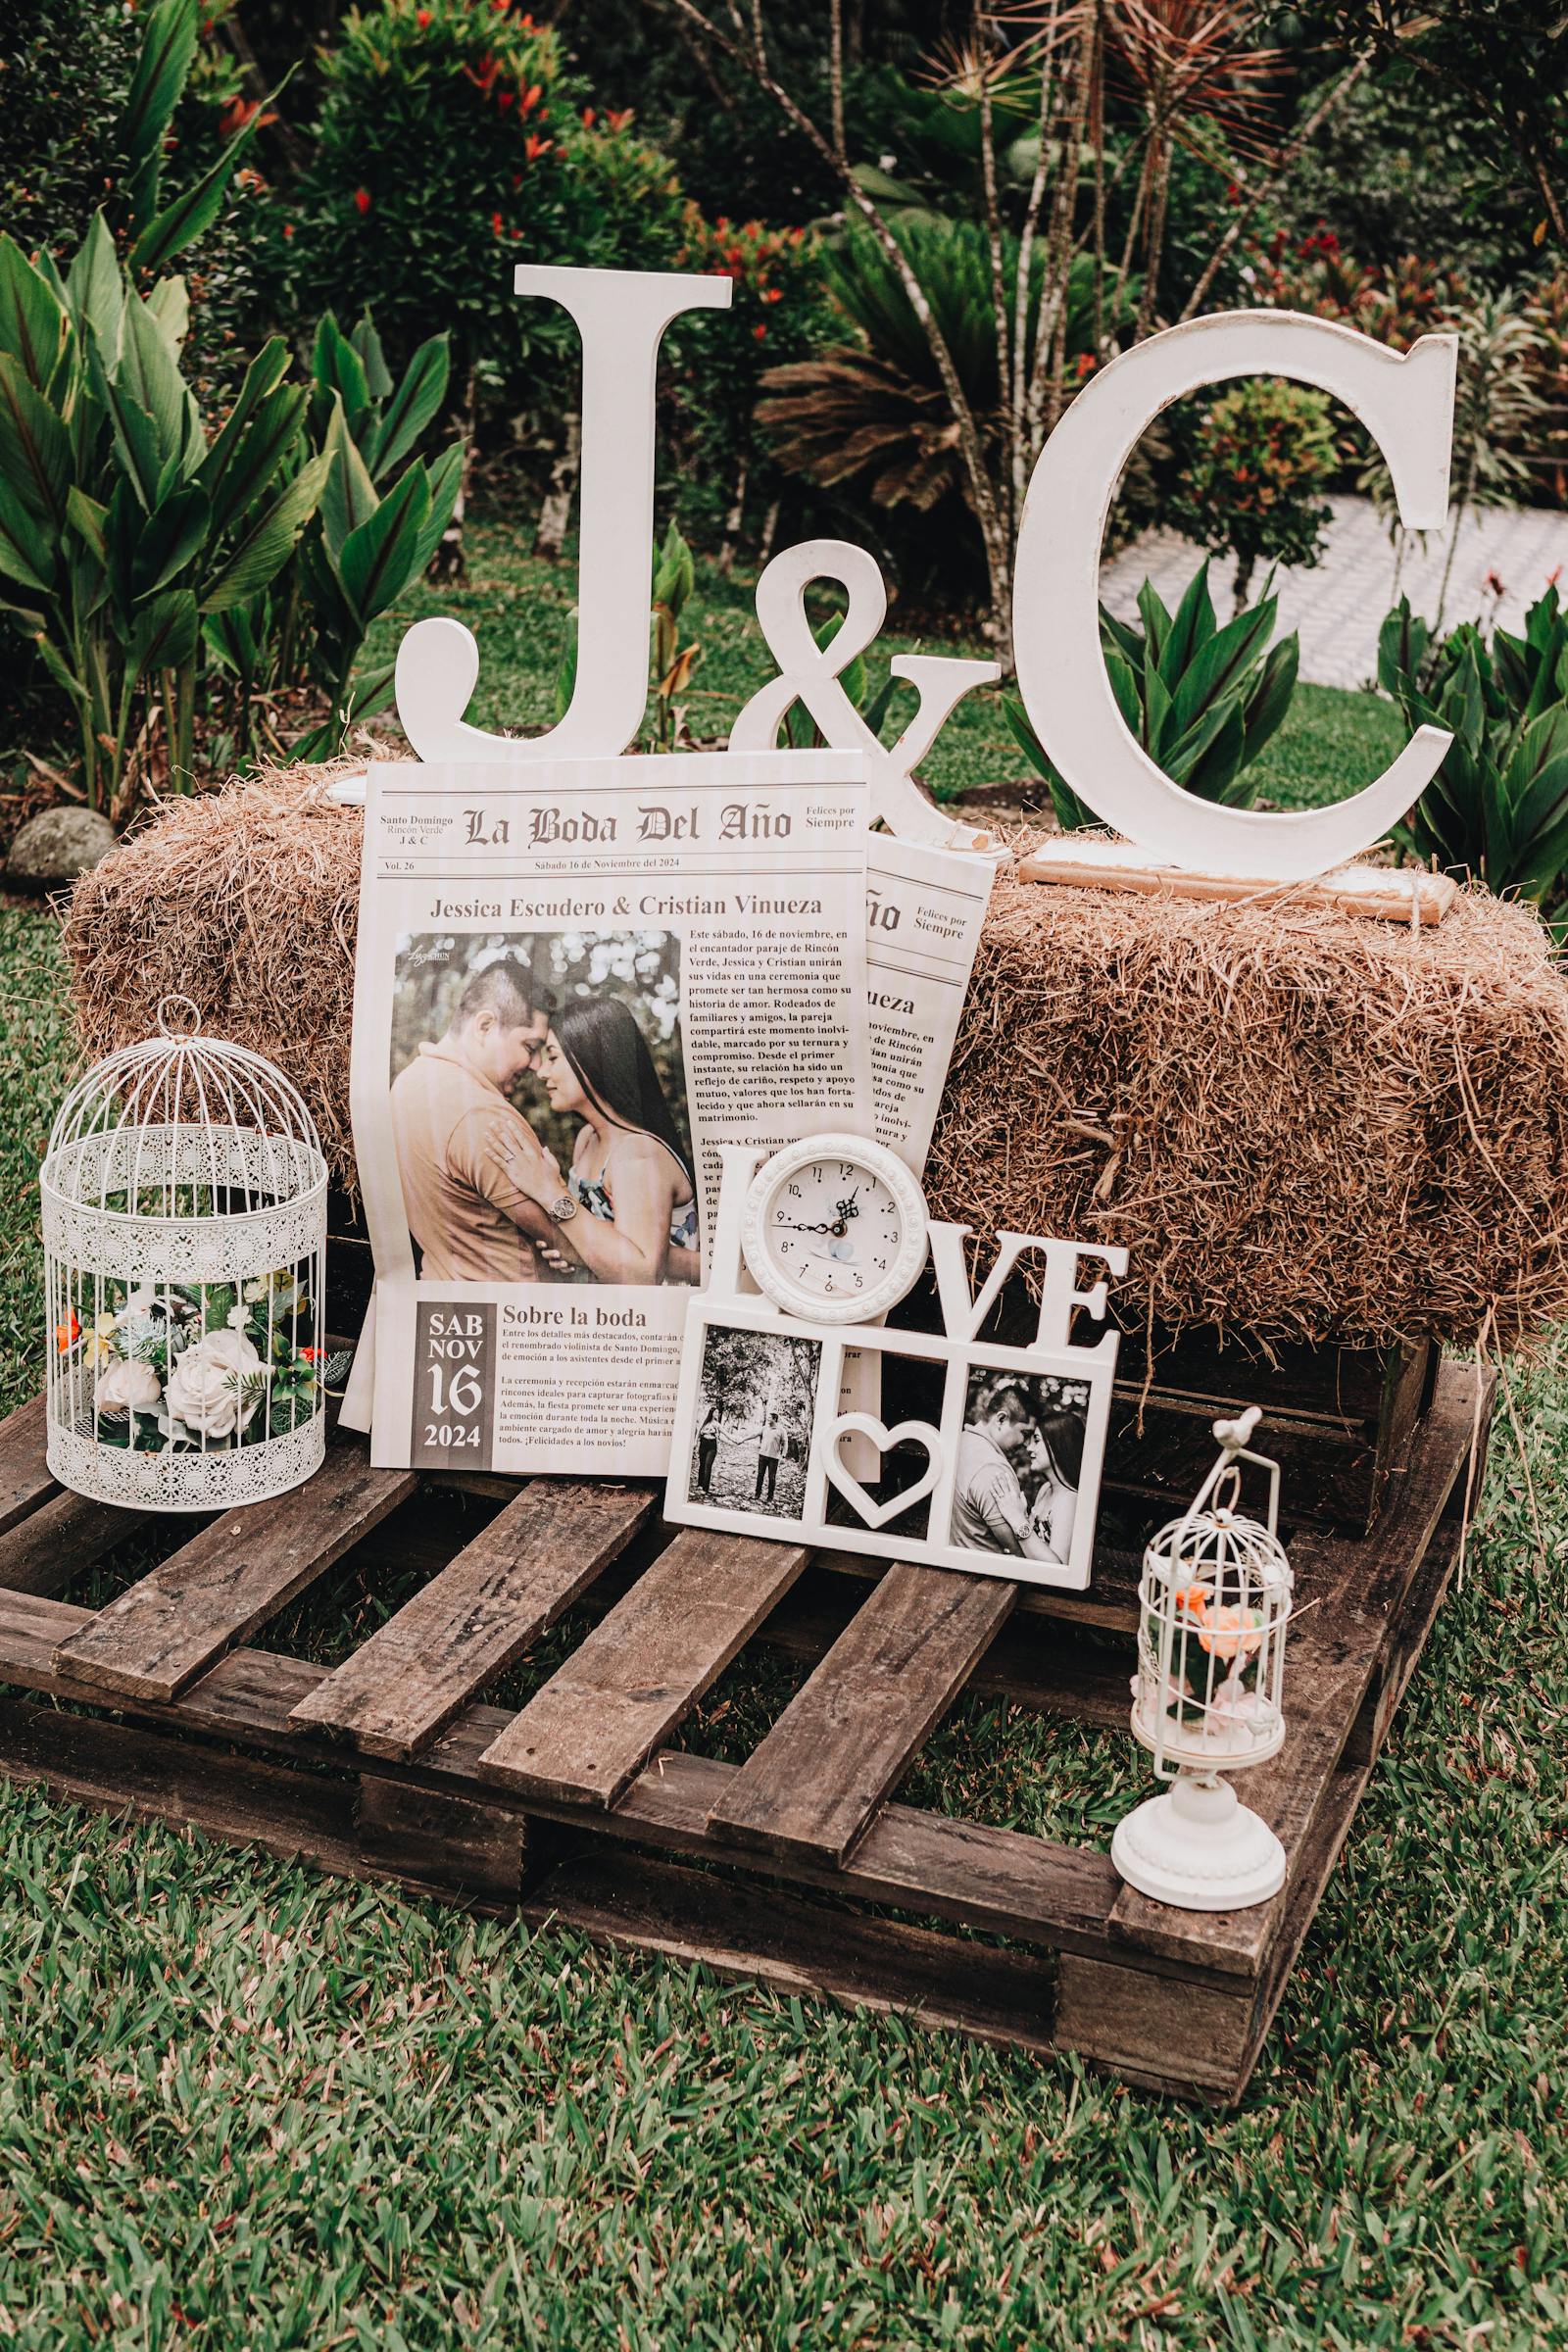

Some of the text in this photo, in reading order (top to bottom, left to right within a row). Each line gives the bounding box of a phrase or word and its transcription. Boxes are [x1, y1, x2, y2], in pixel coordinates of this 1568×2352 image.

[396, 264, 732, 760] J
[1013, 309, 1457, 880] C
[807, 807, 856, 817] Felices por
[381, 815, 453, 826] Santo Domingo
[806, 817, 855, 828] Siempre
[387, 825, 443, 834] Rincón Verde
[463, 803, 792, 850] La Boda Del Año
[400, 836, 406, 845] J
[420, 836, 427, 845] C
[594, 858, 640, 868] Noviembre
[431, 896, 822, 918] Jessica Escudero & Cristian Vinueza
[917, 906, 966, 926] Felices por
[914, 917, 963, 939] Siempre
[701, 944, 753, 953] encantador
[757, 944, 787, 955] paraje
[791, 944, 801, 953] de
[805, 944, 839, 953] Rincón
[690, 958, 719, 967] Verde,
[689, 987, 728, 996] promete
[690, 1000, 725, 1008] historia
[802, 1013, 832, 1023] pareja
[691, 1027, 745, 1037] compartirá
[888, 1039, 923, 1054] Rincón
[693, 1053, 755, 1062] compromiso.
[890, 1054, 922, 1066] unirán
[752, 1063, 790, 1072] relación
[900, 1068, 917, 1079] que
[695, 1078, 725, 1087] reflejo
[743, 1076, 776, 1085] cariño,
[780, 1076, 814, 1085] respeto
[886, 1079, 910, 1090] como
[812, 1166, 821, 1178] 11
[839, 1163, 854, 1176] 12
[871, 1177, 877, 1188] 1
[788, 1184, 800, 1196] 10
[887, 1202, 896, 1213] 2
[777, 1211, 785, 1222] 9
[890, 1232, 898, 1243] 3
[781, 1242, 788, 1252] 8
[878, 1259, 886, 1270] 4
[800, 1267, 807, 1277] 7
[825, 1281, 832, 1292] 6
[856, 1276, 863, 1287] 5
[503, 1305, 646, 1327] Sobre la boda
[430, 1313, 483, 1336] SAB
[593, 1332, 638, 1341] destacados,
[427, 1340, 483, 1358] NOV
[427, 1363, 482, 1416] 16
[424, 1425, 480, 1446] 2024
[525, 1437, 573, 1446] ¡Felicidades
